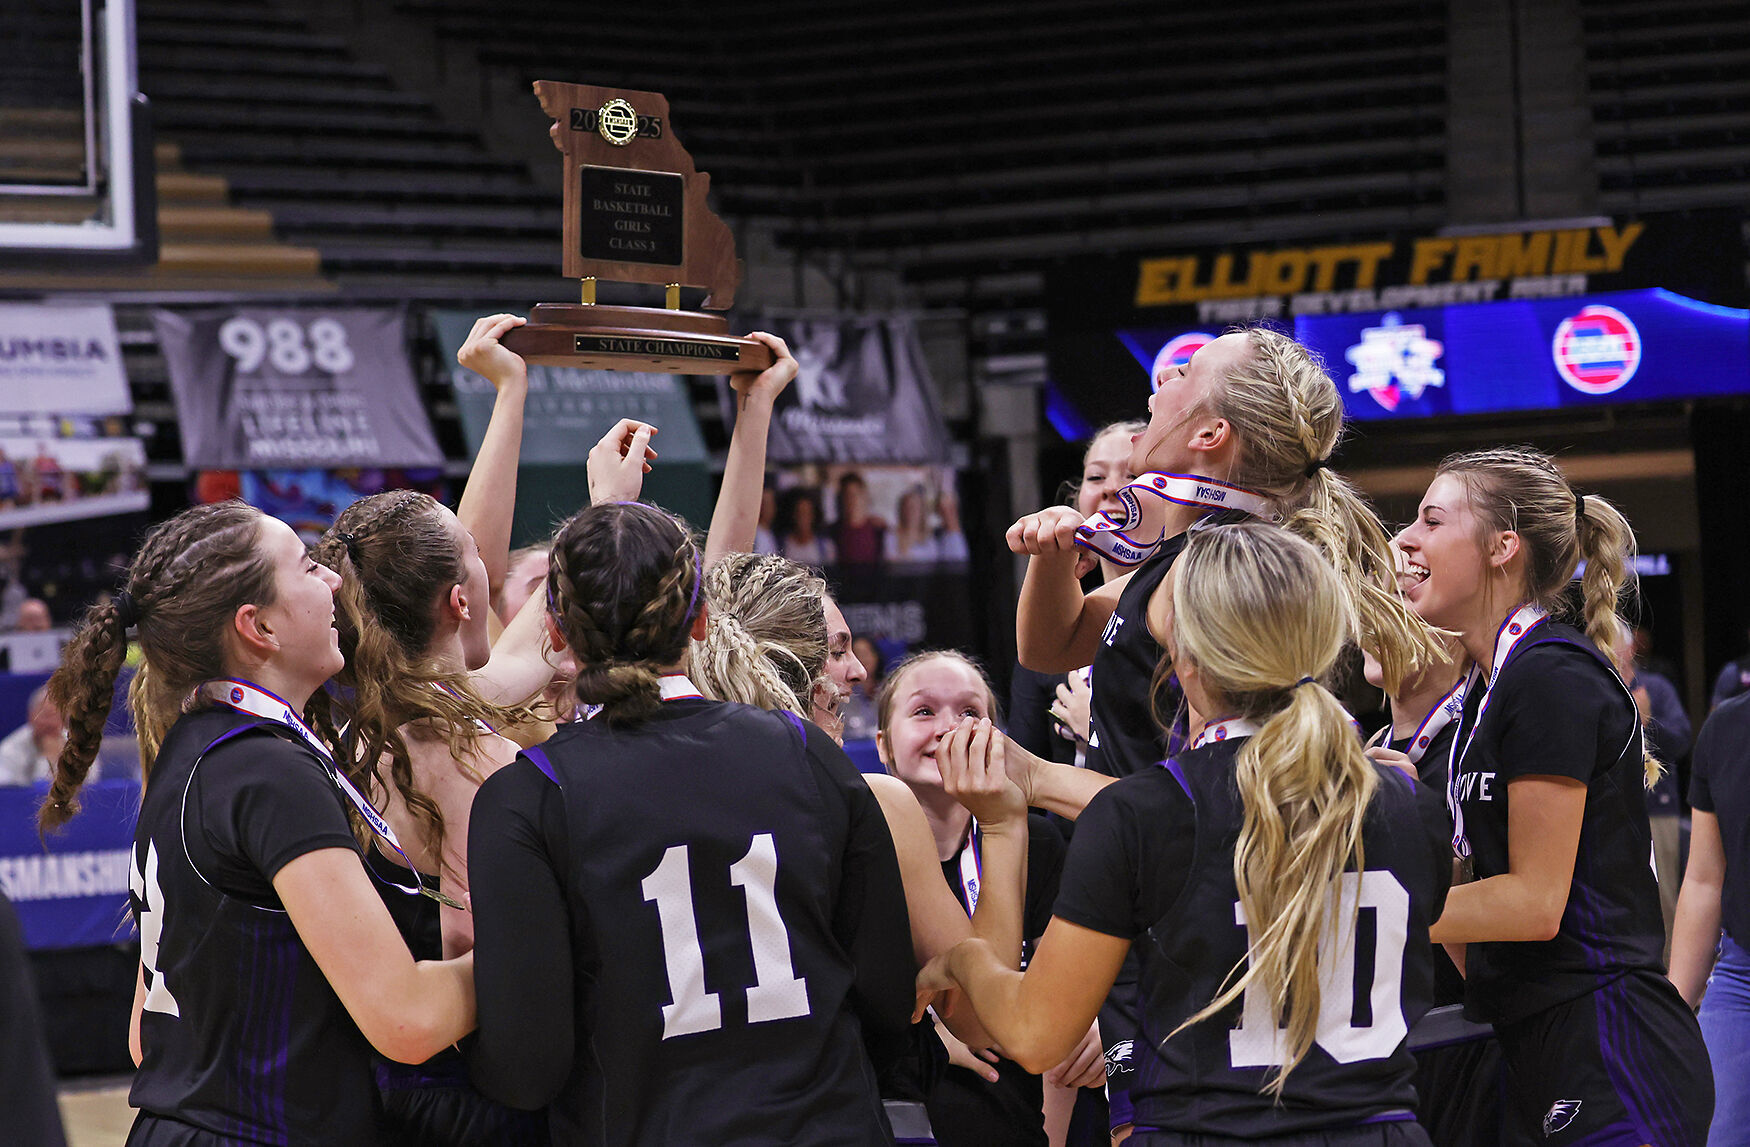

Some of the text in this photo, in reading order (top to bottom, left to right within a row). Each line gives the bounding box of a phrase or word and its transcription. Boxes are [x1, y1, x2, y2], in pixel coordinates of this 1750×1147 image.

[572, 110, 661, 138] 20 25
[614, 184, 651, 197] STATE
[593, 199, 672, 217] BASKETBALL
[614, 219, 651, 233] GIRLS
[609, 237, 647, 251] CLASS
[1135, 223, 1645, 306] ELLIOTT FAMILY
[1290, 280, 1500, 316] DEVELOPMENT
[219, 317, 354, 374] 988
[600, 339, 722, 357] STATE CHAMPIONS
[1122, 491, 1137, 524] MSHSAA
[1196, 485, 1227, 502] MSHSAA
[1112, 542, 1142, 560] MSHSAA
[283, 710, 309, 740] MSHSAA
[361, 803, 388, 836] MSHSAA
[641, 832, 811, 1041] 11
[1229, 870, 1410, 1068] 10
